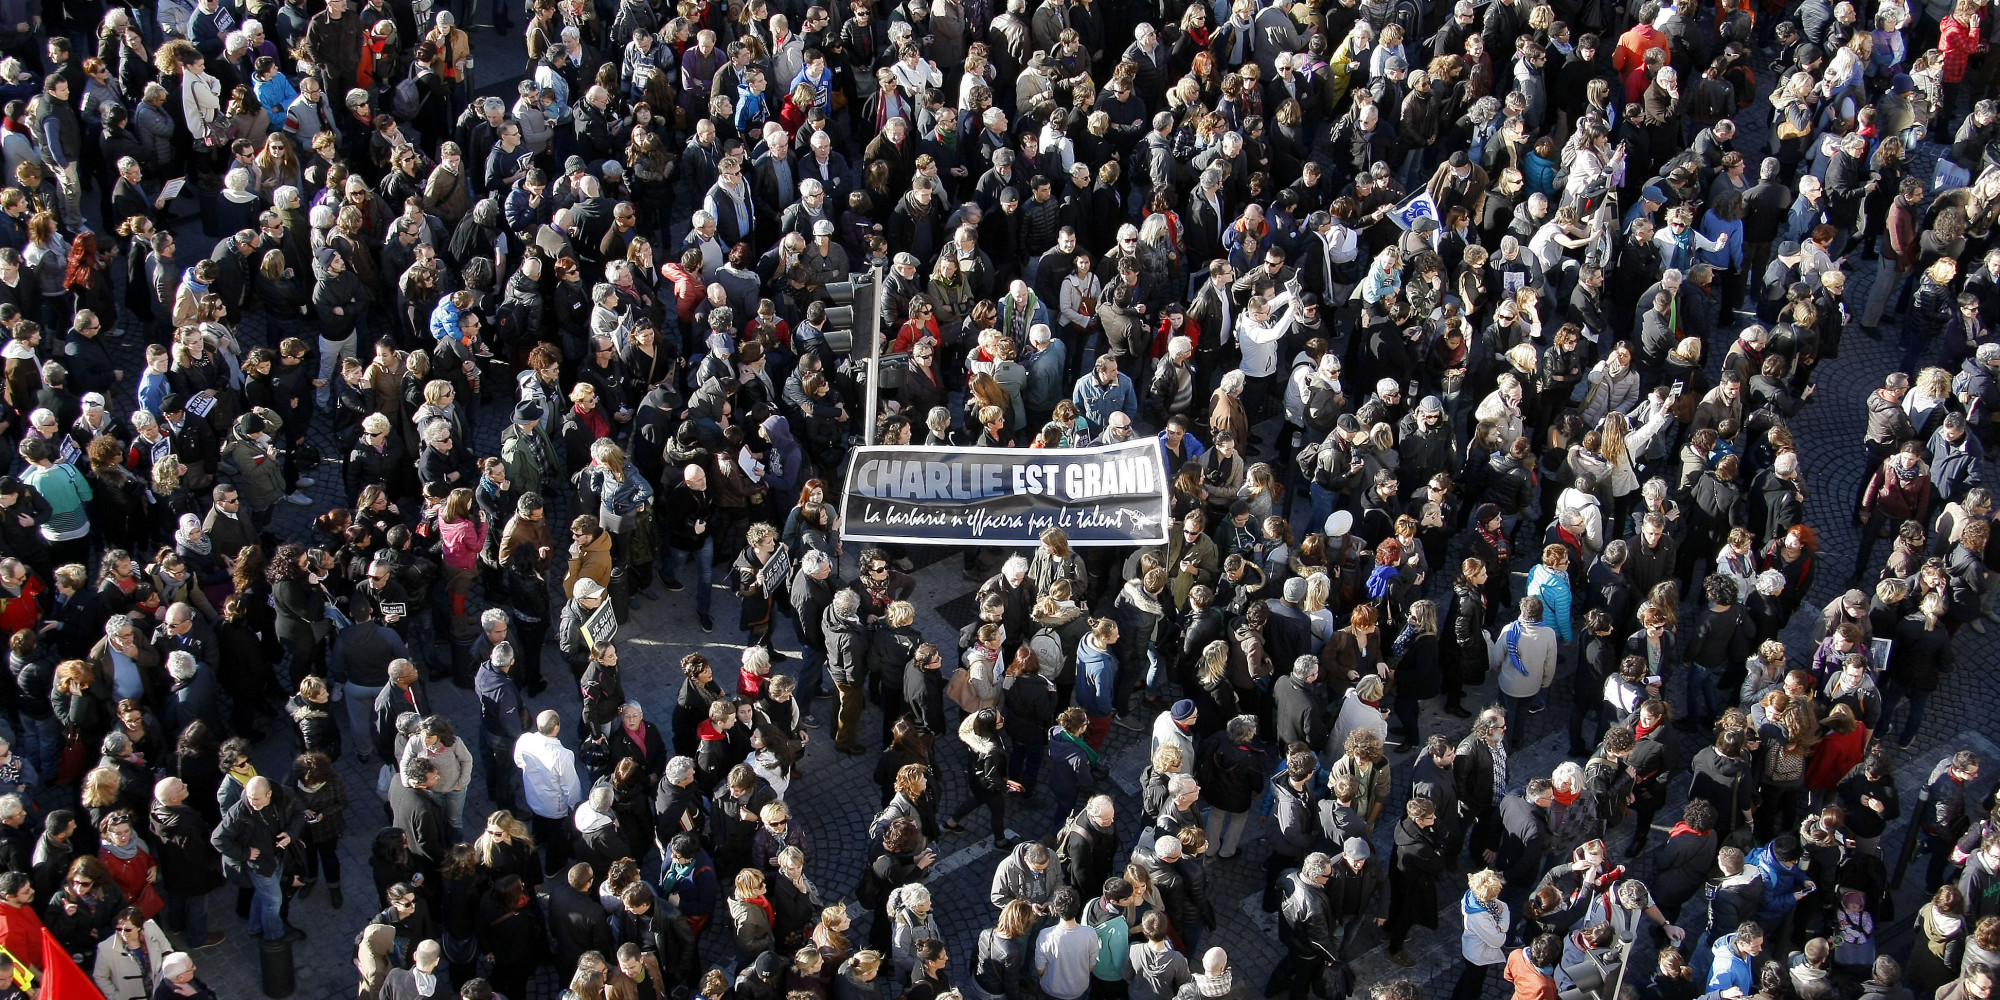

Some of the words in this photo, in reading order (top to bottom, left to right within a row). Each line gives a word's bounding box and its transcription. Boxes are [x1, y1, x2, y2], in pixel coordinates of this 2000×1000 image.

[857, 459, 1005, 499] CHARLIE
[1012, 464, 1059, 496] EST
[1065, 455, 1155, 500] GRAND
[864, 503, 881, 524] La
[885, 505, 947, 526] barbarie
[951, 507, 1024, 537] n'effacera
[1027, 512, 1054, 536] pas
[1058, 506, 1072, 528] le
[1076, 504, 1123, 529] talent
[765, 568, 774, 582] JE
[592, 622, 601, 637] JE
[599, 606, 612, 628] SUIS
